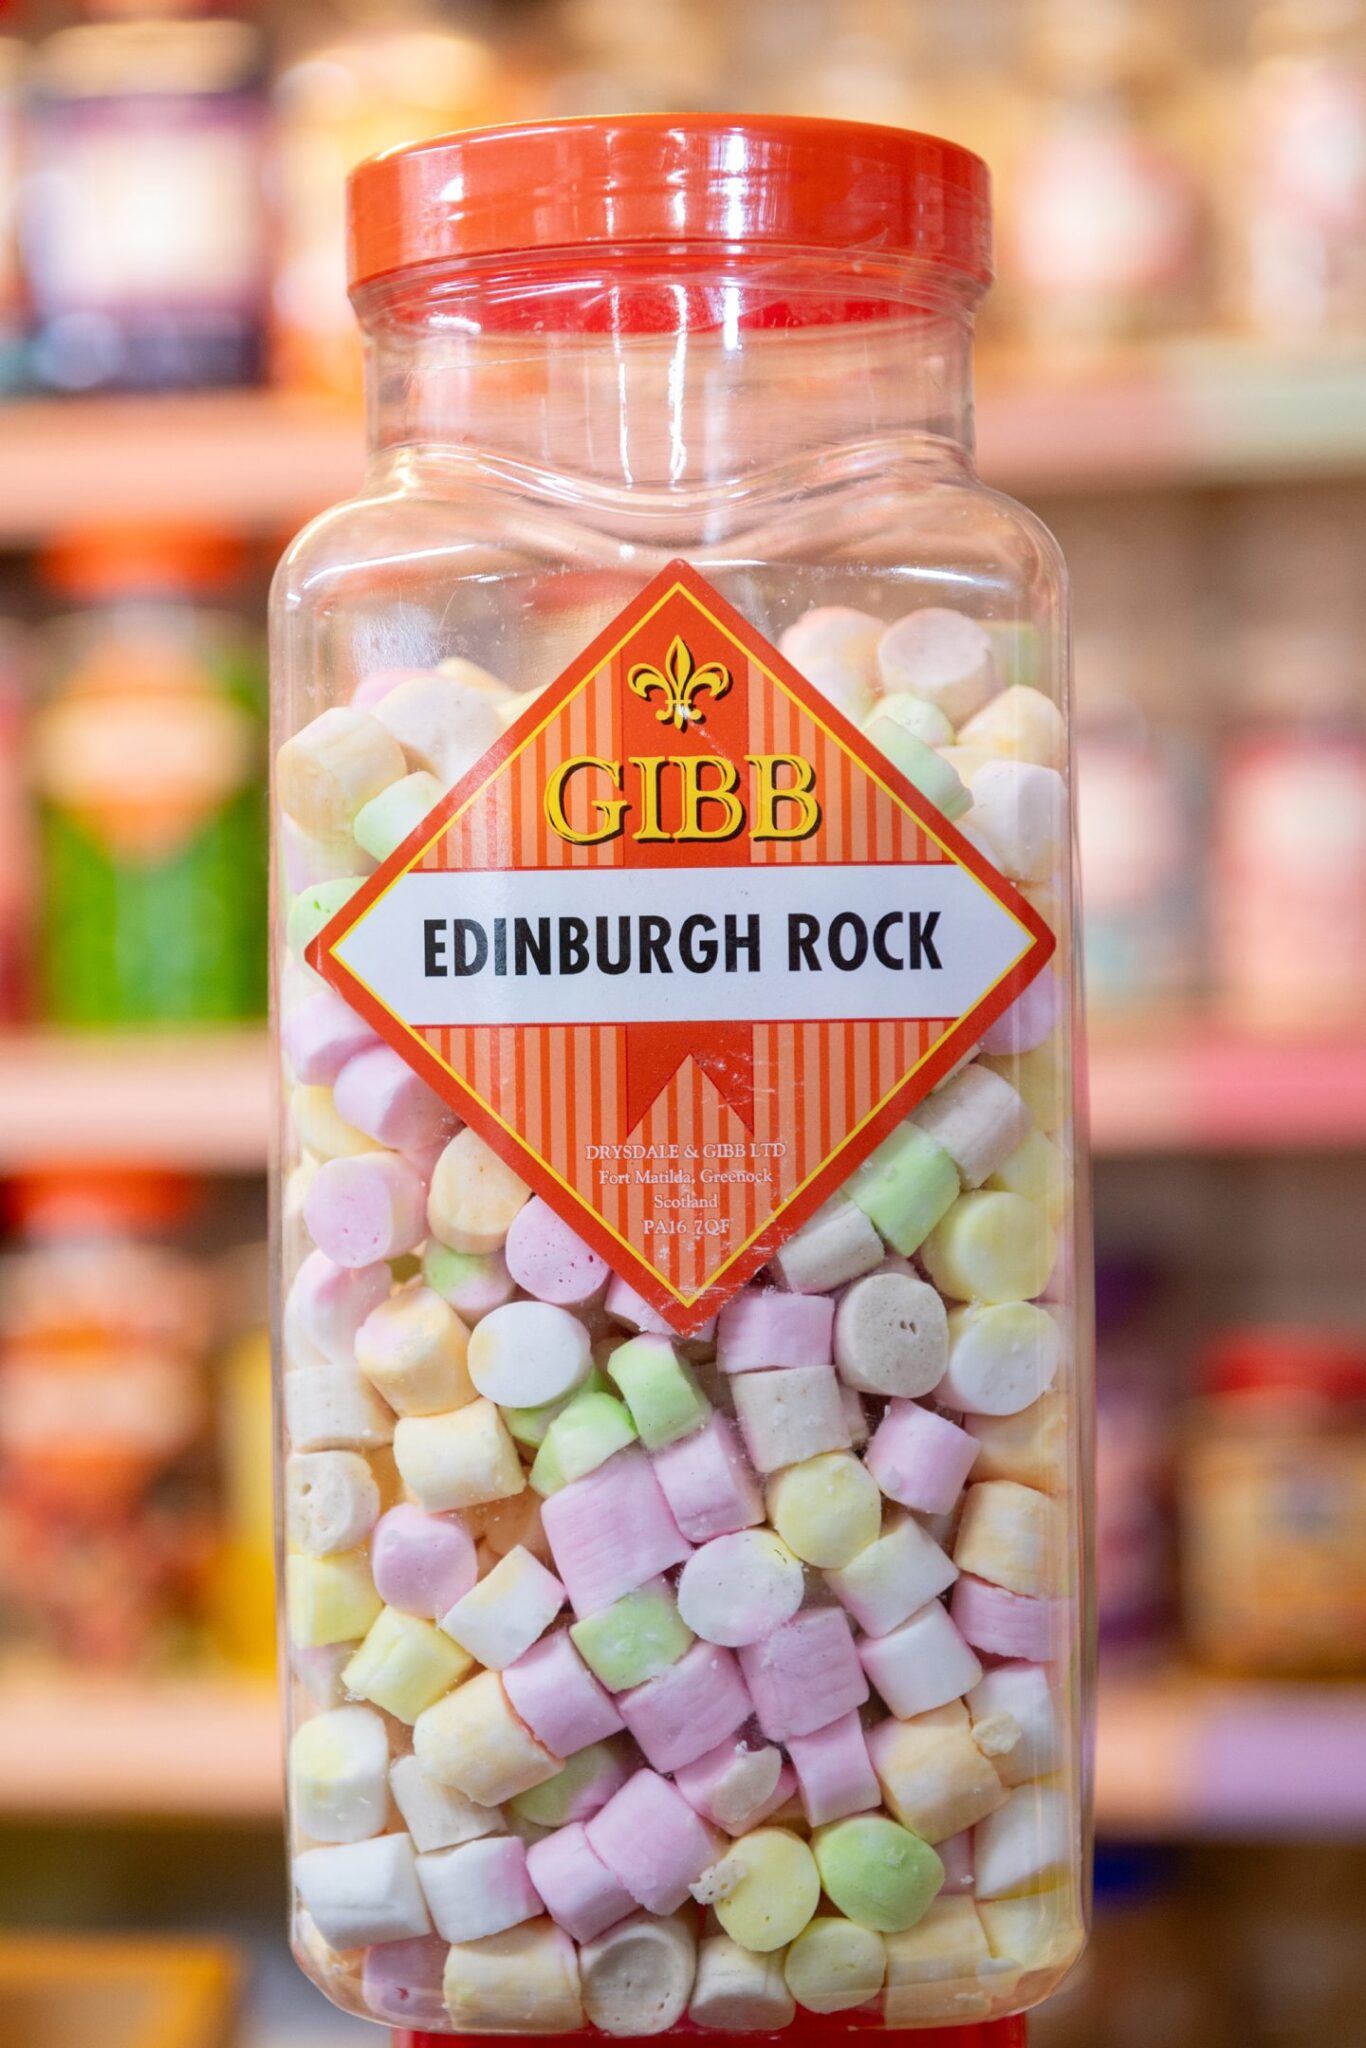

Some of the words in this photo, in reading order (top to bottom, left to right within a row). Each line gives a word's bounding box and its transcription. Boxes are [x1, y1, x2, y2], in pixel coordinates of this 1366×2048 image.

[544, 754, 822, 846] GIBB
[424, 913, 761, 978] EDINBURGH
[787, 911, 944, 972] ROCK
[585, 1144, 679, 1160] DRYSDALE
[683, 1144, 700, 1158] &
[703, 1143, 746, 1159] GIBB
[751, 1142, 787, 1158] LTD
[599, 1170, 631, 1185] Fort
[634, 1169, 696, 1185] Matilda,
[700, 1168, 773, 1185] Greenock
[654, 1193, 719, 1209] Scotland
[643, 1219, 687, 1235] PA16
[694, 1218, 731, 1235] 7QF
